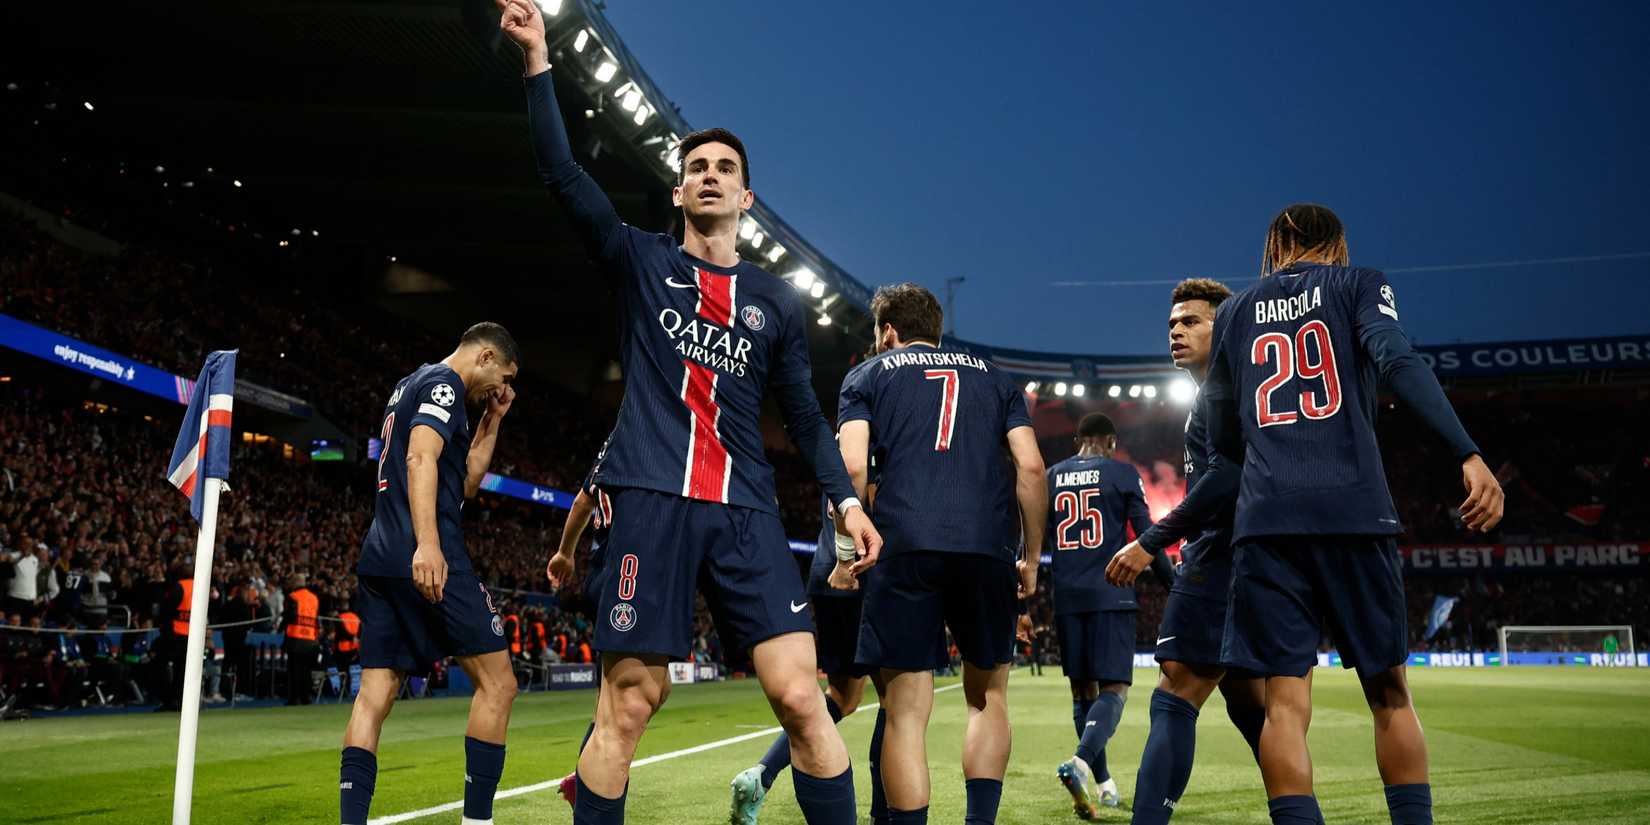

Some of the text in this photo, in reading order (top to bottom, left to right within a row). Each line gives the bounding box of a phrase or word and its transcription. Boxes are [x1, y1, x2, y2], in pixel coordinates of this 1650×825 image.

[1254, 286, 1322, 324] BARCOLA
[659, 307, 752, 363] QATAR
[54, 345, 123, 377] enjoy responsibly
[675, 340, 747, 377] AIRWAYS
[881, 352, 989, 374] KVARATSKHELIA
[1471, 341, 1650, 369] COULEUR
[1250, 319, 1342, 428] 29
[923, 368, 960, 451] 7
[1056, 470, 1100, 488] N.MENDES
[1054, 488, 1104, 551] 25
[1411, 546, 1494, 568] C'EST
[1504, 544, 1547, 567] AU
[1552, 543, 1641, 567] PARC
[65, 575, 81, 590] 87
[618, 553, 638, 601] 8
[1430, 653, 1484, 667] REUSE
